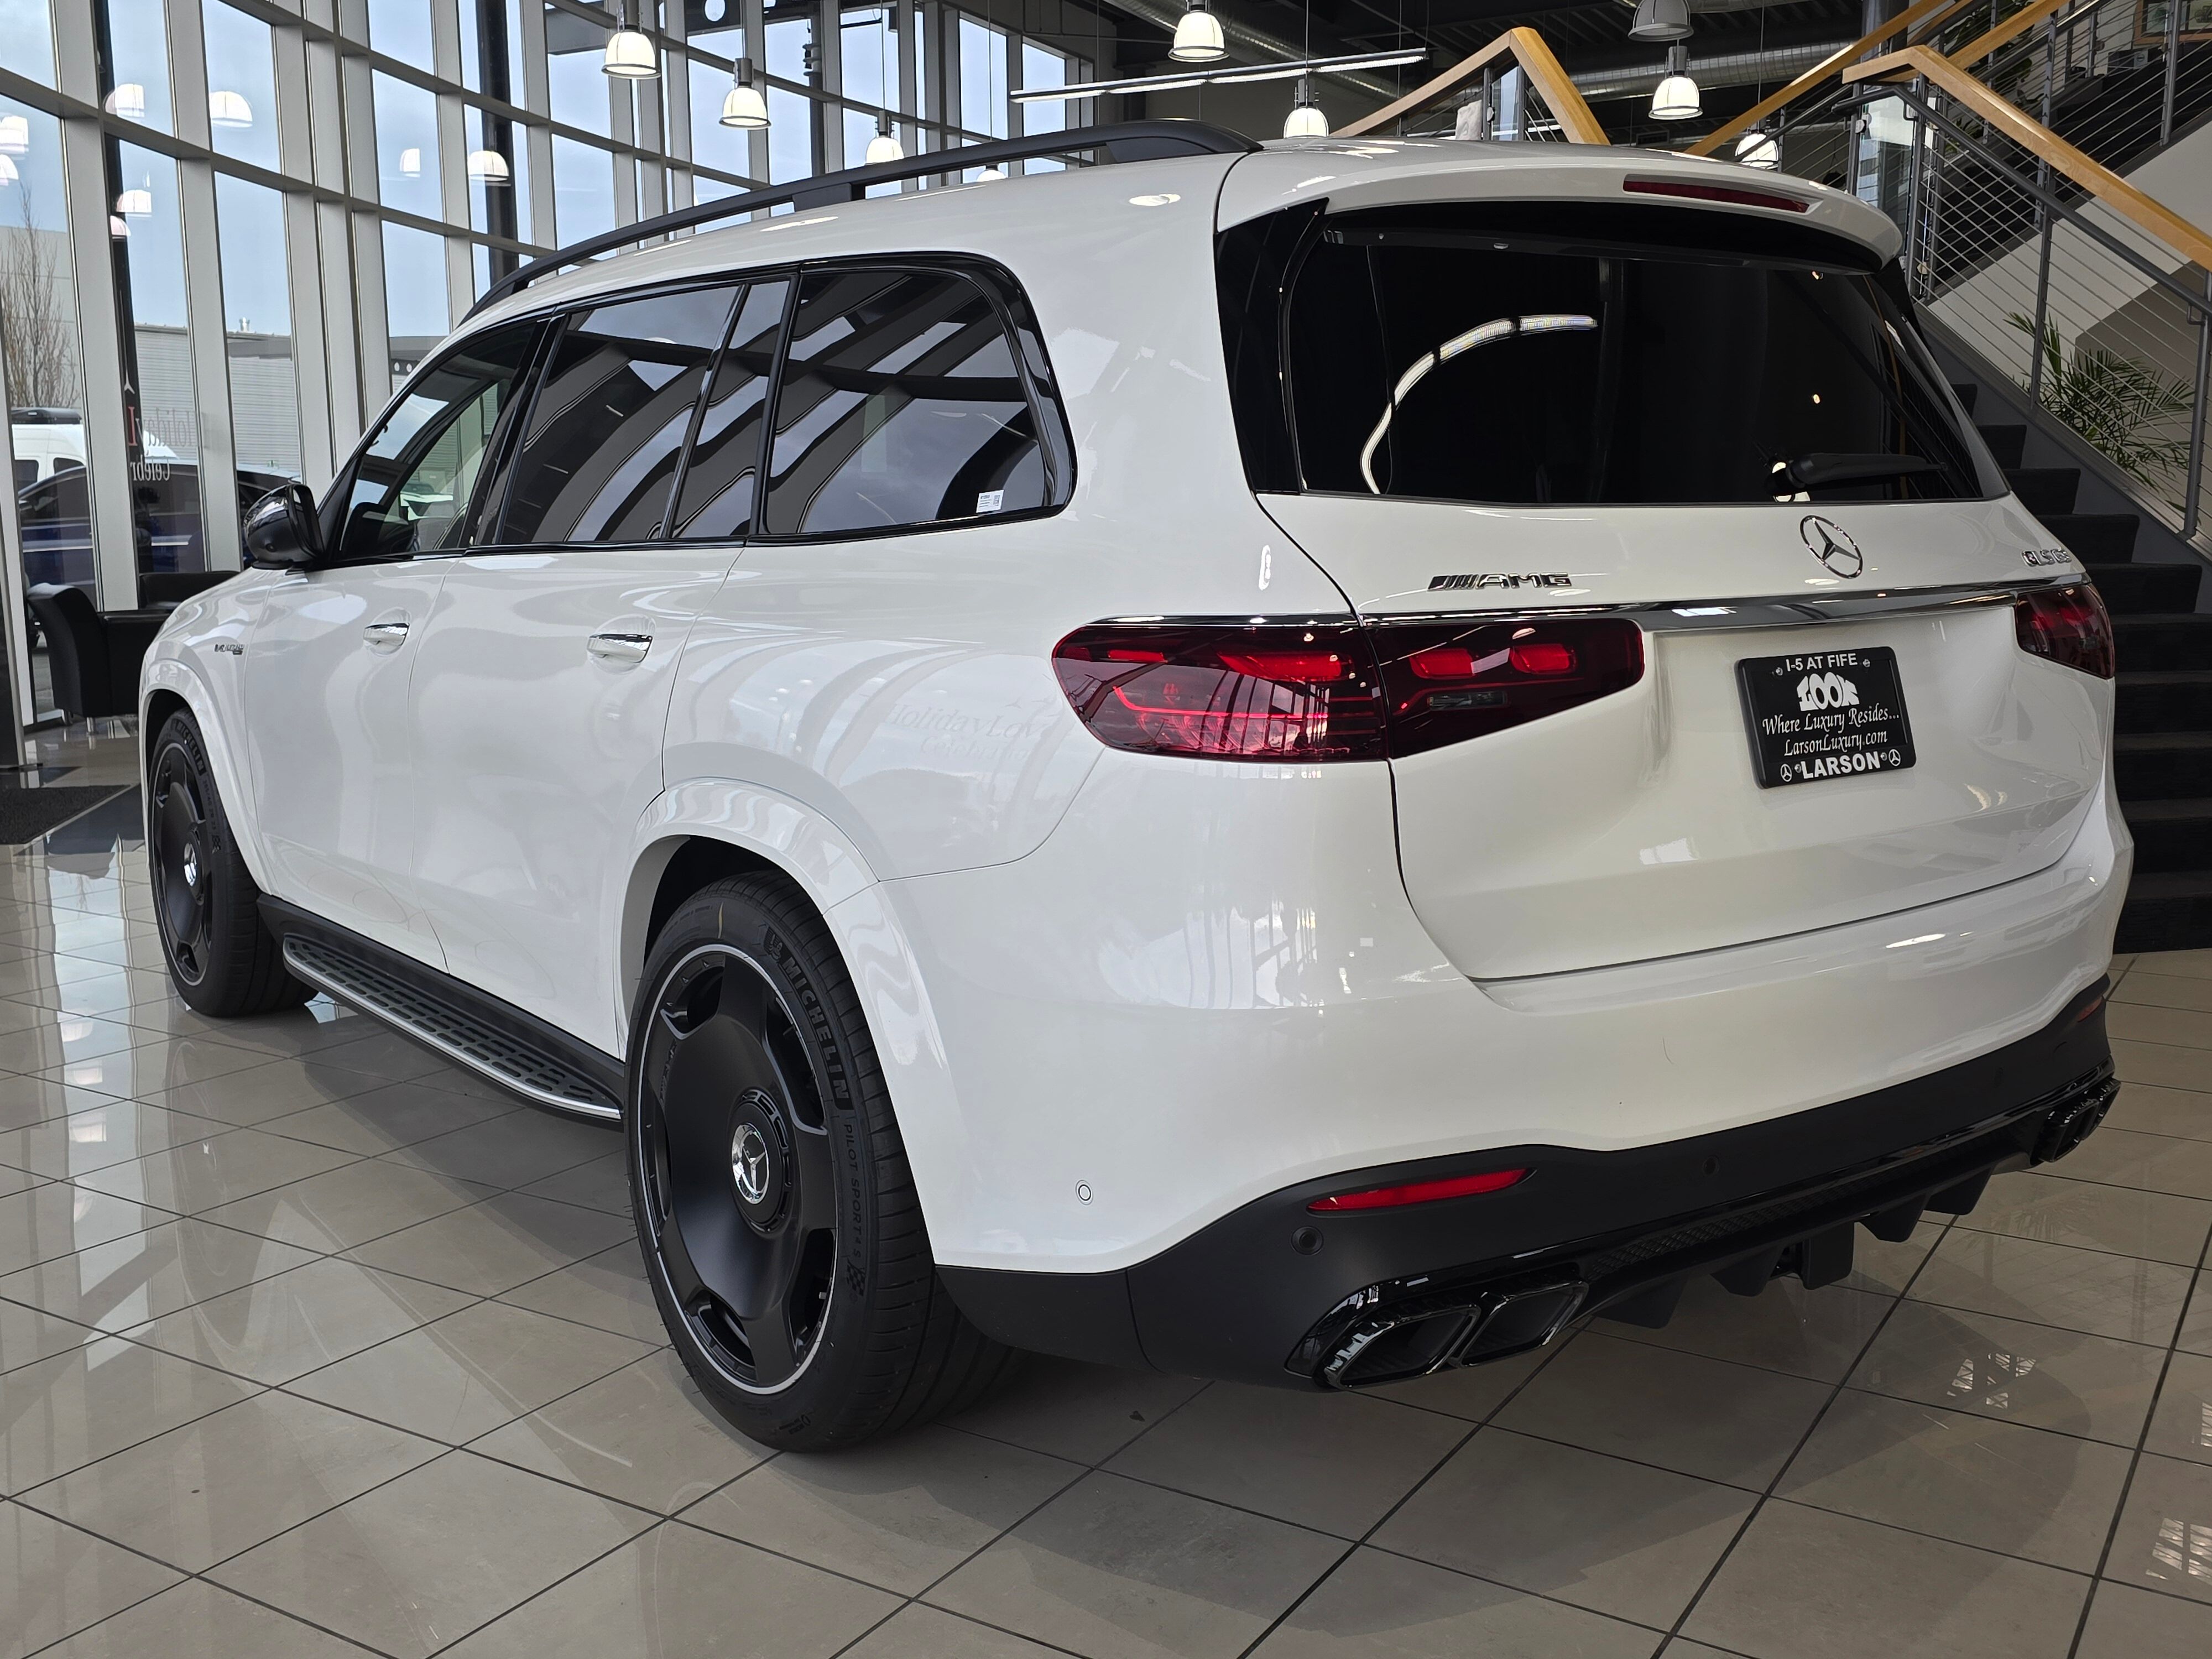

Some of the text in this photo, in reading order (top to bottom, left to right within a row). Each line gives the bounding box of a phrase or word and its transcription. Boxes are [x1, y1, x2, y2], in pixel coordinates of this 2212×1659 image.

[1786, 653, 1858, 672] I-5 AT FIFE
[1762, 703, 1900, 735] Where Luxury Resides...
[176, 721, 205, 771] MICHELIN
[1784, 730, 1888, 757] LarsonLuxury.com
[1801, 751, 1881, 779] LARSON
[783, 957, 849, 1099] MICHELIN
[843, 1124, 859, 1172] PILOT
